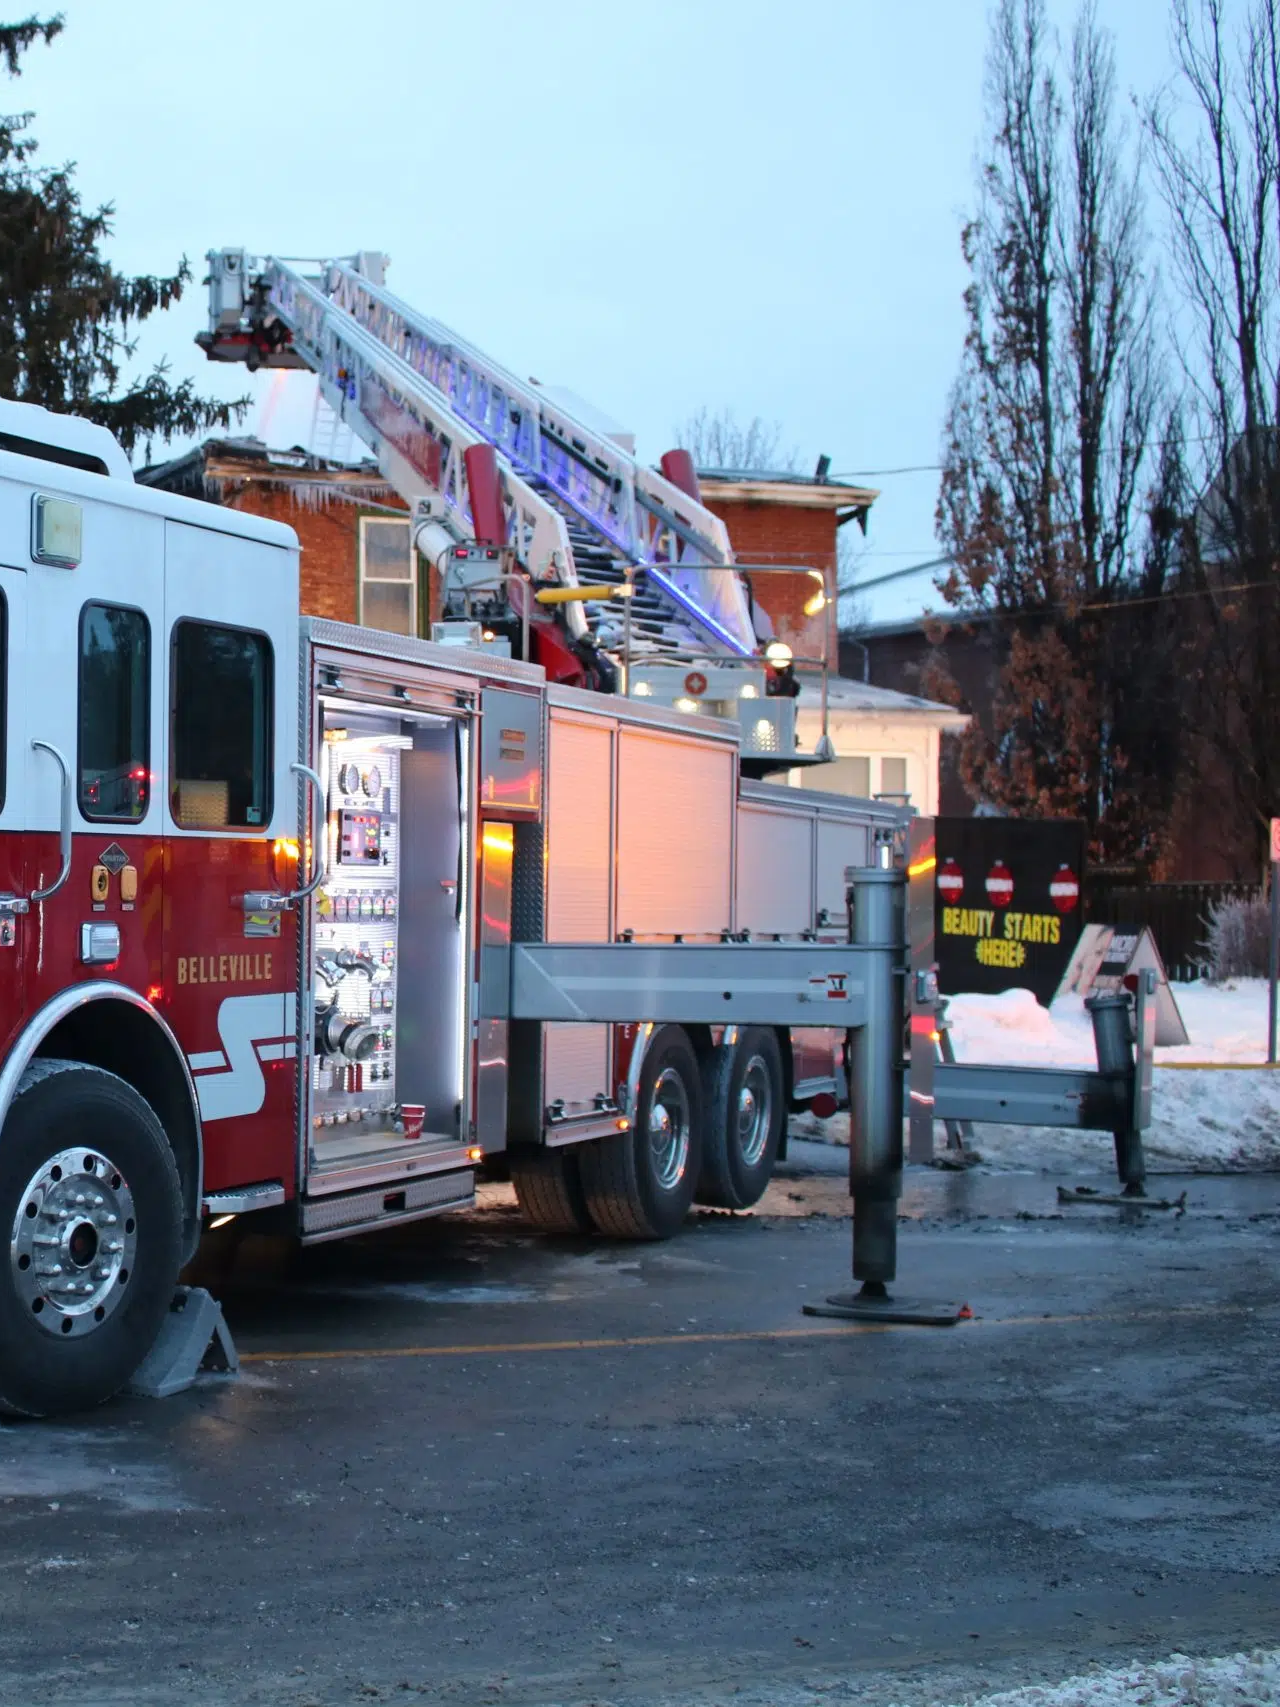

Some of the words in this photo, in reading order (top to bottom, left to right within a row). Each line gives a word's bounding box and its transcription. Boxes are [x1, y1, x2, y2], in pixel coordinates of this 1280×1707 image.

[942, 907, 995, 937] BEAUTY
[1003, 911, 1061, 944] STARTS
[177, 953, 273, 985] BELLEVILLE
[983, 938, 1018, 968] HERE
